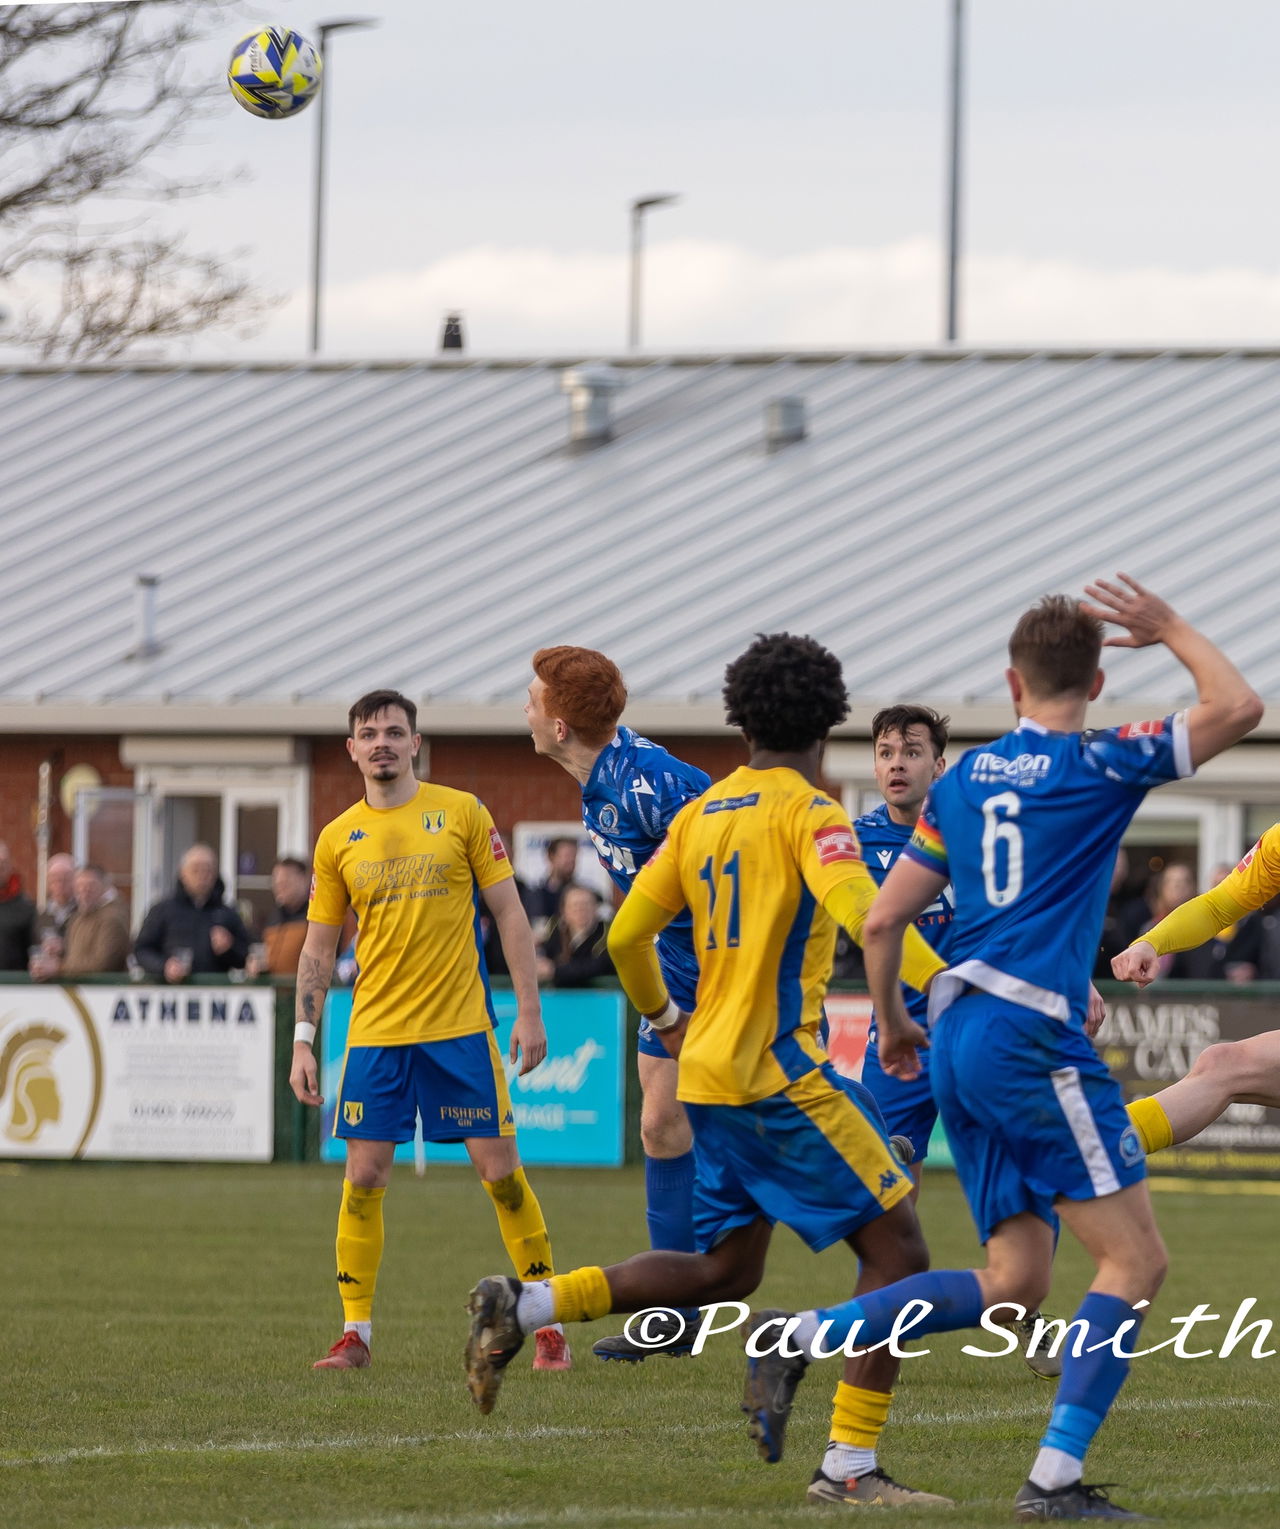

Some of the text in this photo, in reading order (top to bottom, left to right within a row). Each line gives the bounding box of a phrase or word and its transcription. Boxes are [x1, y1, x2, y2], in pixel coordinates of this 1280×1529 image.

[981, 791, 1024, 909] 6
[409, 887, 449, 899] LOGISTICS
[699, 850, 741, 950] 11
[113, 998, 256, 1023] ATHENA
[440, 1106, 492, 1120] FISHERS
[457, 1118, 473, 1127] GIN
